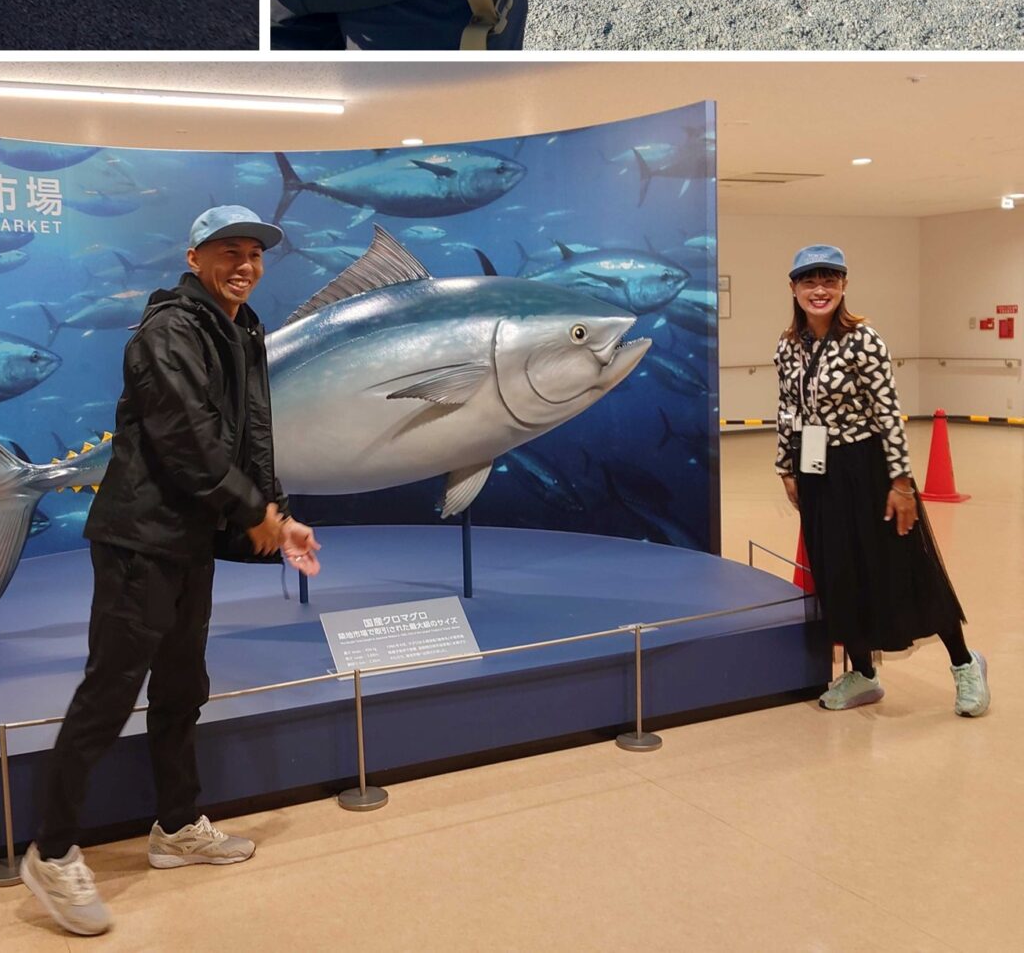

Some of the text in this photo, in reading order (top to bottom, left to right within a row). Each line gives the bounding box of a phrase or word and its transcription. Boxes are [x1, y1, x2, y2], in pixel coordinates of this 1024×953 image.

[362, 611, 428, 628] 国産クロマグロ
